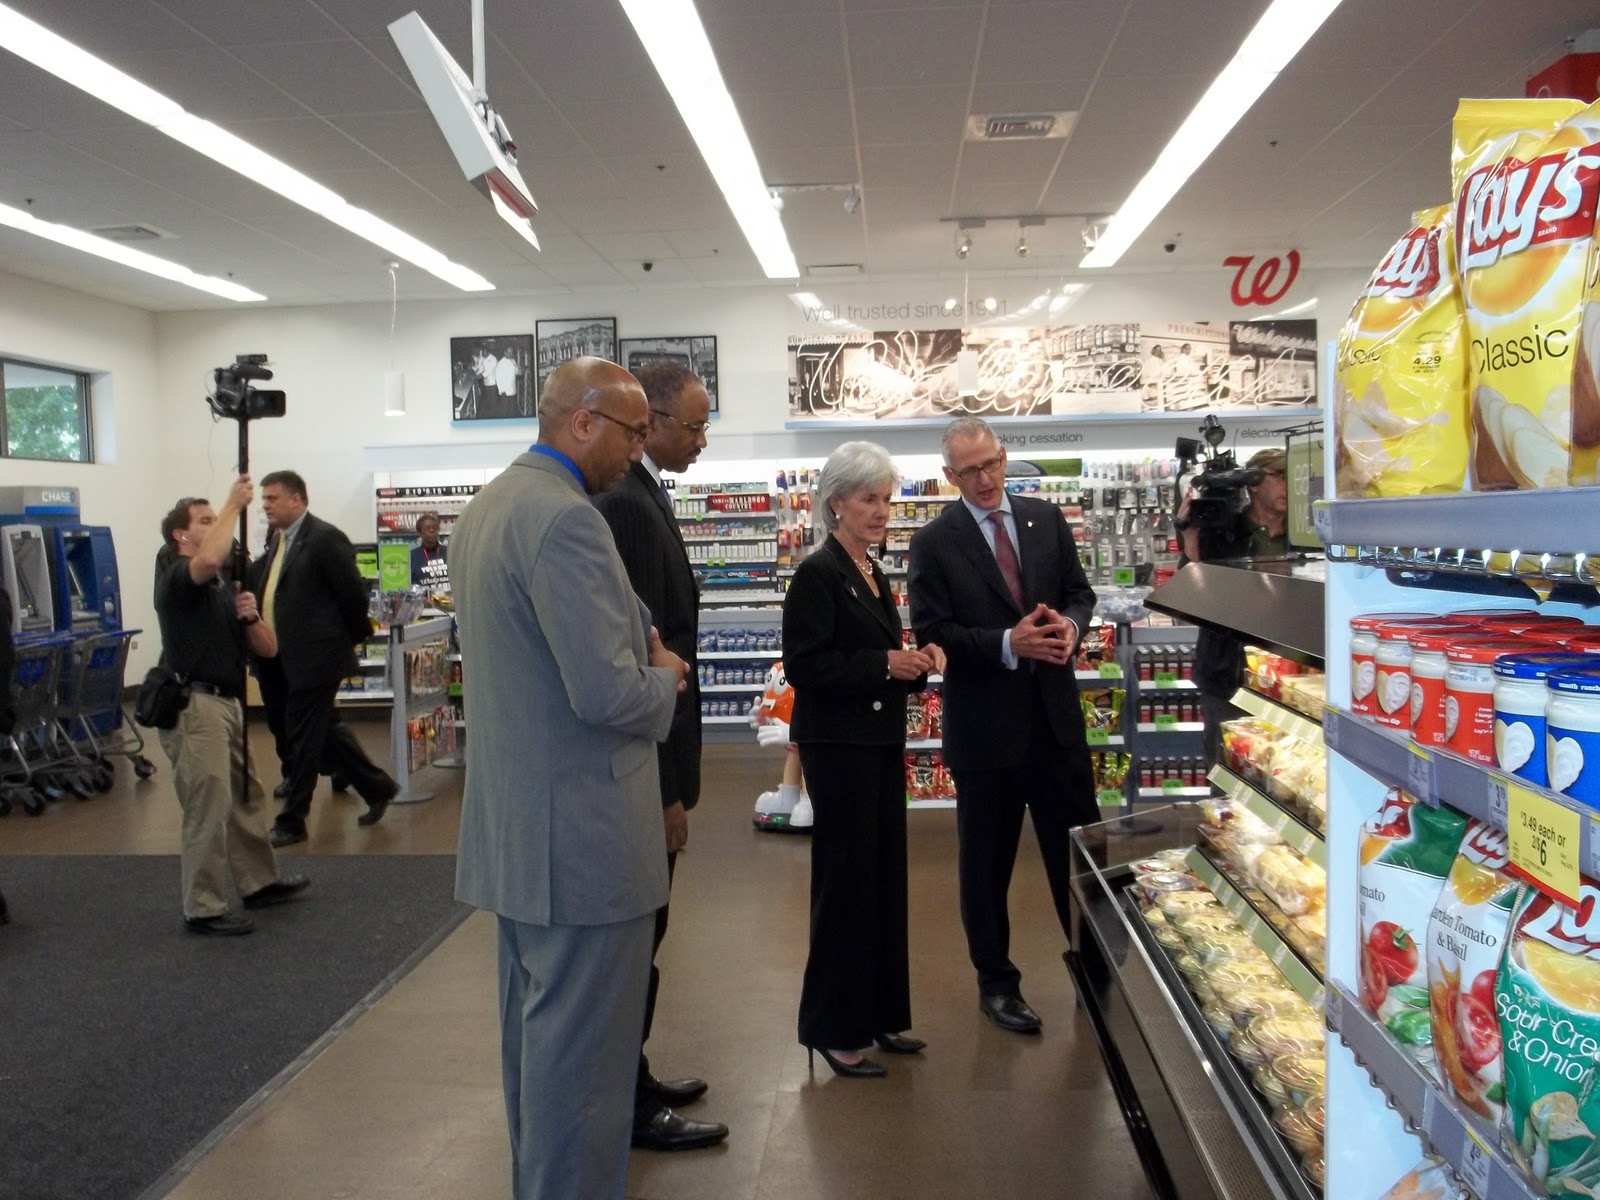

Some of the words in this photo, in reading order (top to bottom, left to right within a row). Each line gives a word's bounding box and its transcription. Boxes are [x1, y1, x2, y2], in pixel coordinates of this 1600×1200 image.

[1460, 147, 1600, 273] Lay's
[1537, 226, 1558, 237] BRAND
[803, 305, 841, 322] Well
[847, 302, 910, 321] trusted
[914, 299, 963, 318] since
[1413, 354, 1442, 366] 4.29
[1471, 323, 1569, 374] Classic
[996, 433, 1027, 447] oking
[1029, 431, 1083, 444] cessation
[1240, 427, 1288, 439] electron
[1294, 463, 1316, 496] ea
[41, 490, 71, 503] CHASE
[725, 503, 752, 512] COUNTRY
[728, 496, 766, 504] MARLBORO
[1538, 823, 1556, 843] each
[1557, 834, 1567, 849] or
[1360, 884, 1386, 902] mato
[1431, 906, 1455, 932] arden
[1454, 914, 1498, 948] Tomato
[1436, 930, 1446, 947] &
[1446, 933, 1468, 962] Basil
[1508, 1030, 1529, 1053] &
[1552, 1019, 1600, 1063] Cre
